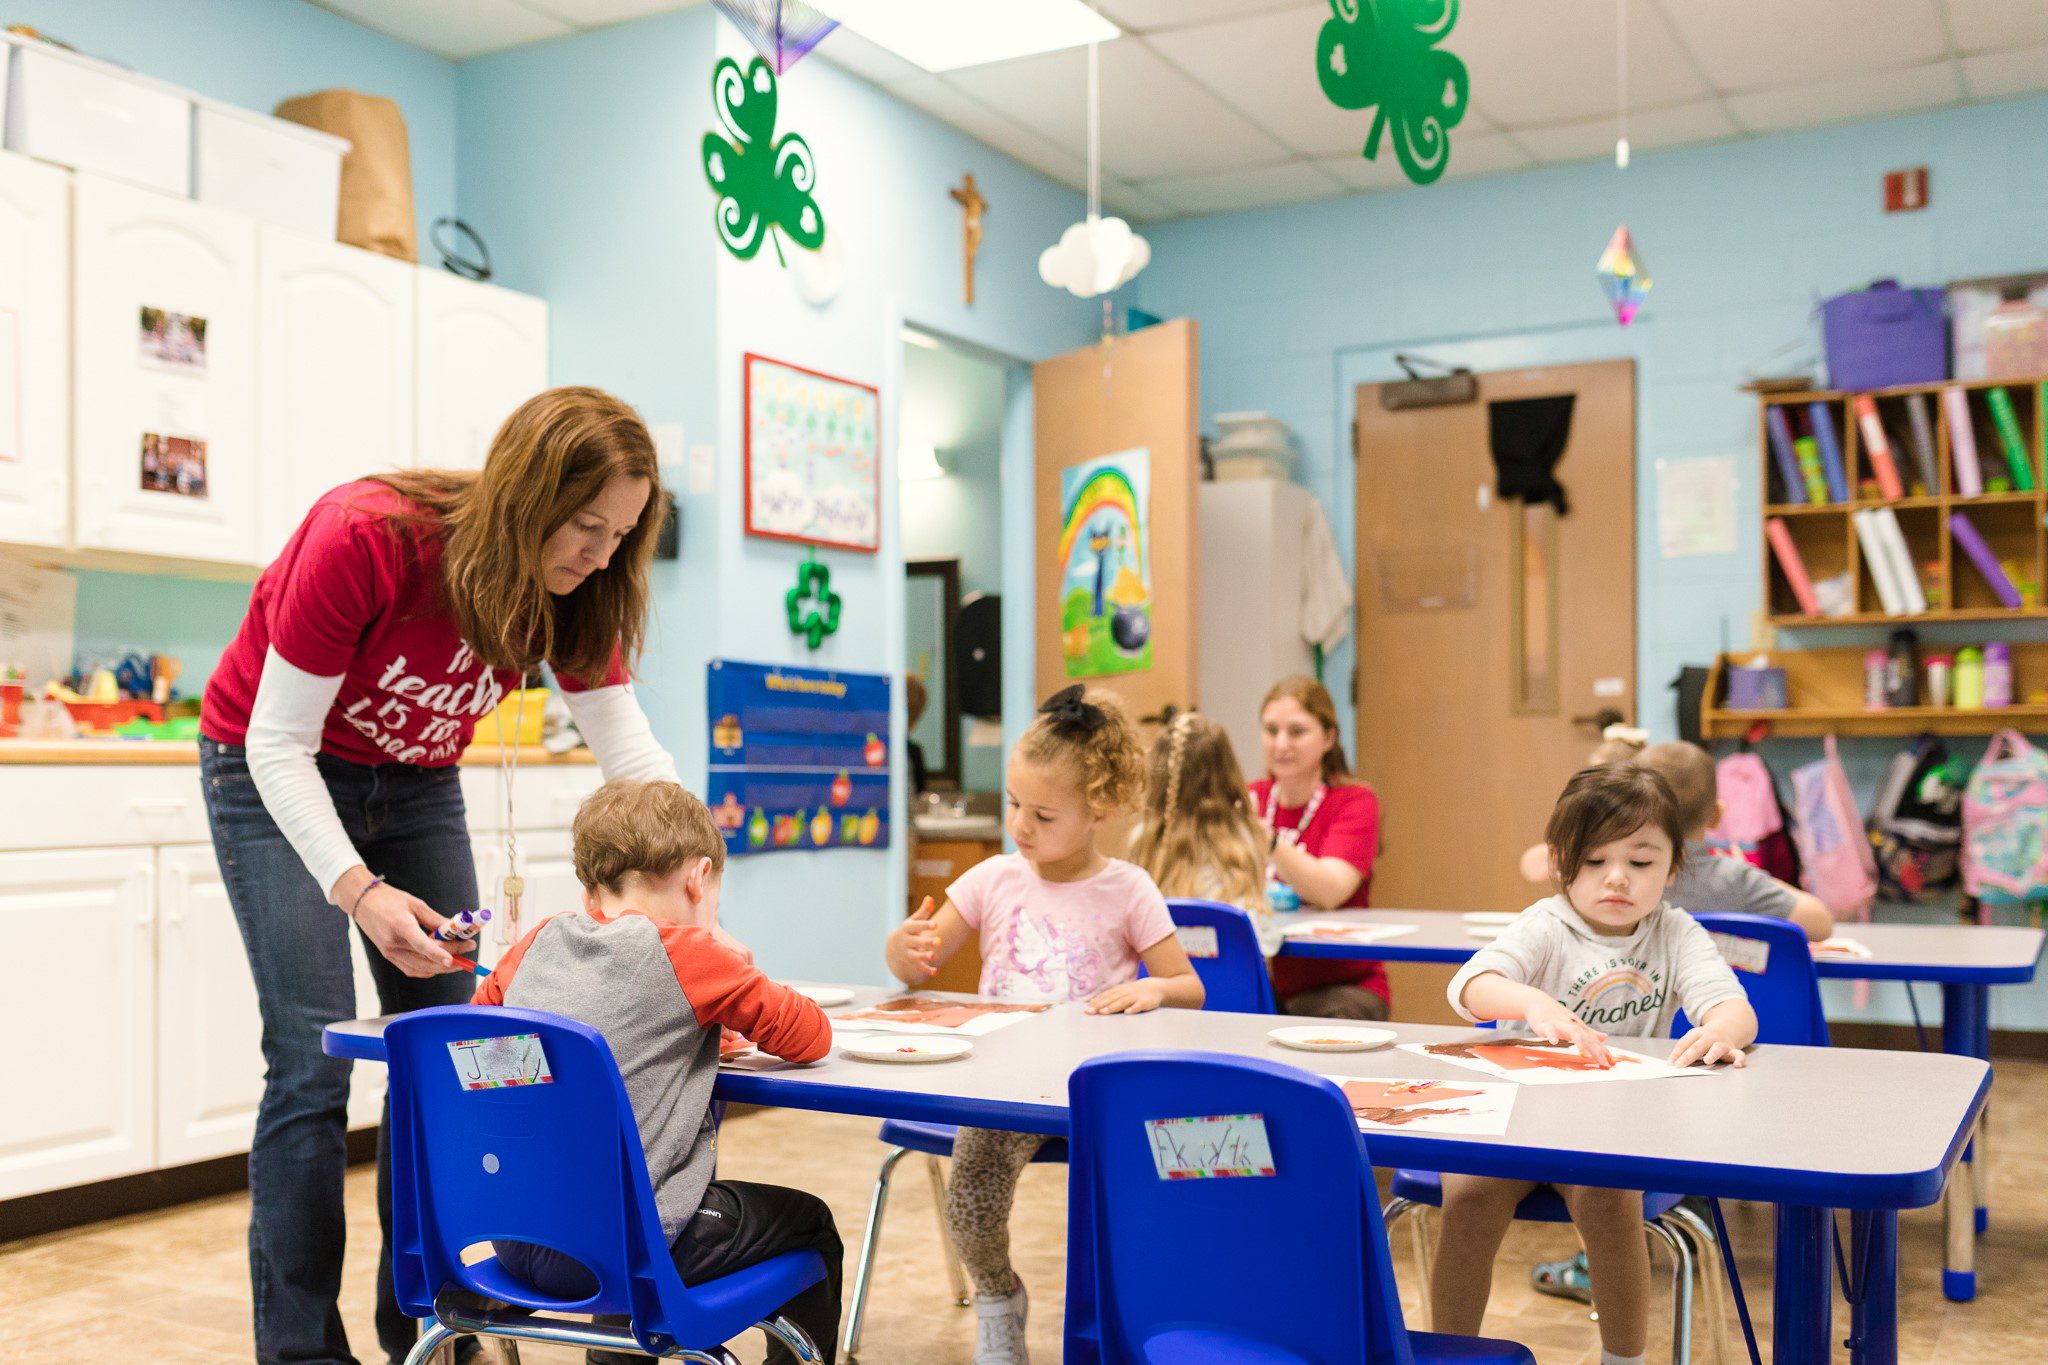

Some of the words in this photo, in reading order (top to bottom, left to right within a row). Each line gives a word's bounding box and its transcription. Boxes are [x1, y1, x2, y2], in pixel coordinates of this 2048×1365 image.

[378, 655, 503, 716] teach
[1567, 967, 1600, 997] THERE
[1604, 958, 1617, 969] IS
[1649, 969, 1662, 983] IN
